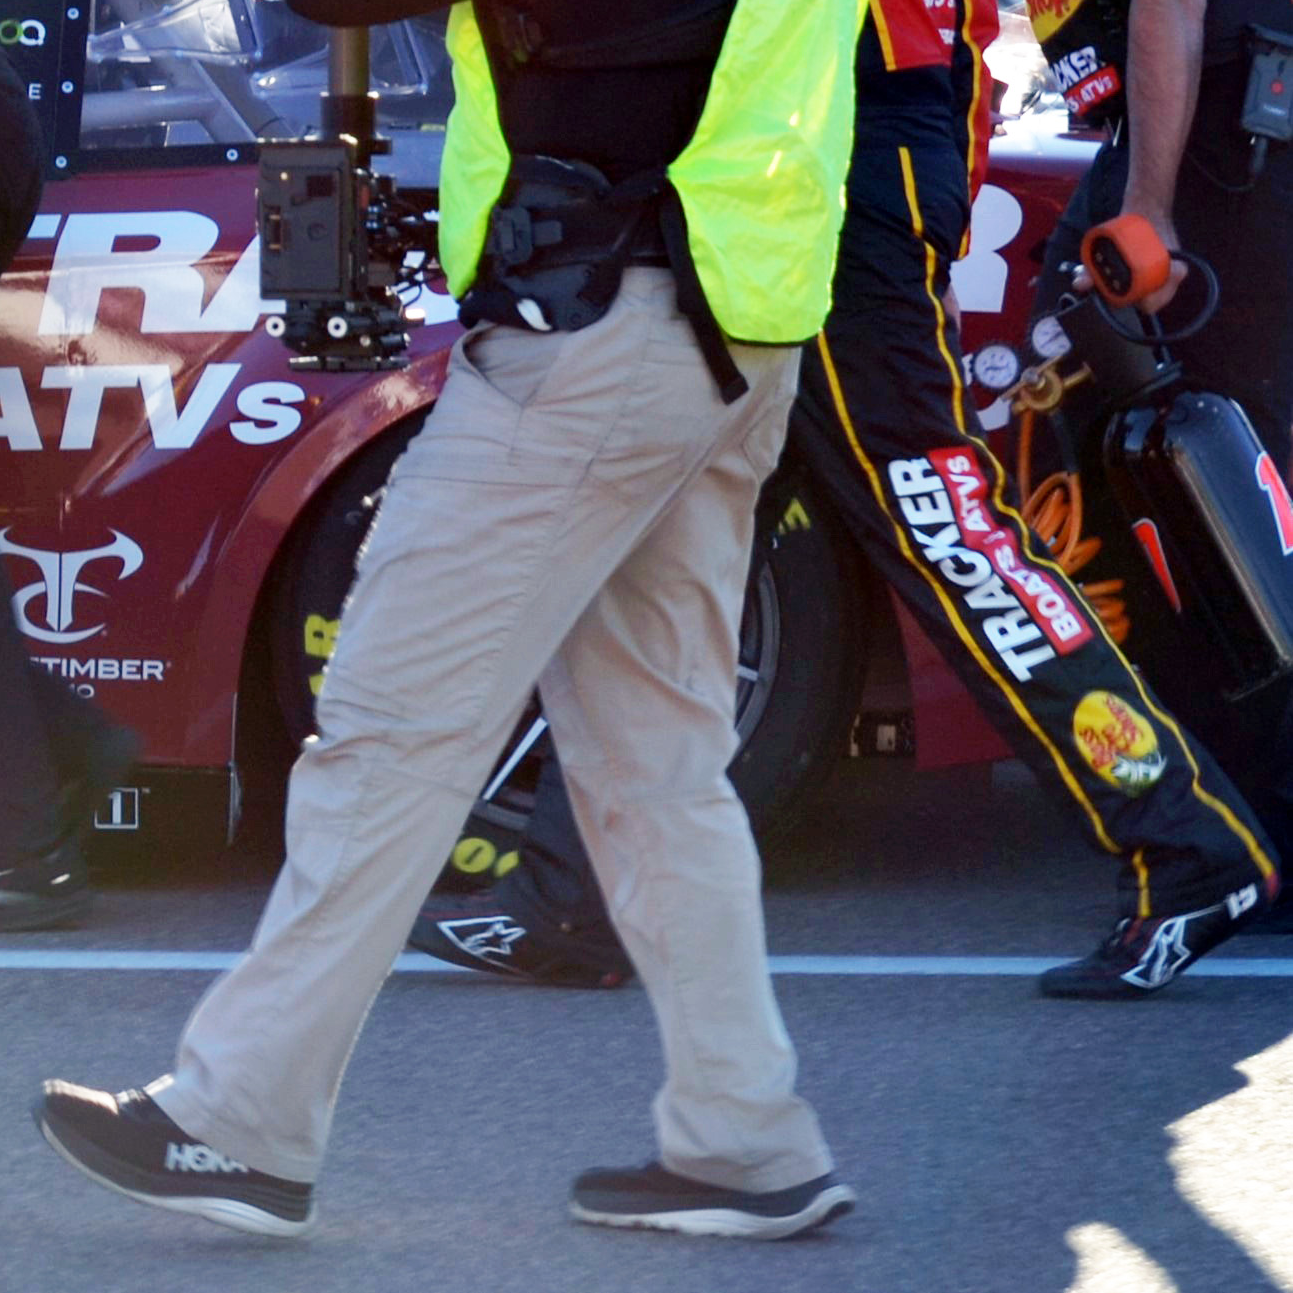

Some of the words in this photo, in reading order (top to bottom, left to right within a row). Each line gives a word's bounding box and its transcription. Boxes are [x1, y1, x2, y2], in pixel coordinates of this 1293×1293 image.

[888, 457, 1057, 682] TRACKER
[994, 544, 1083, 643] BOATS
[30, 657, 164, 681] TIMBER
